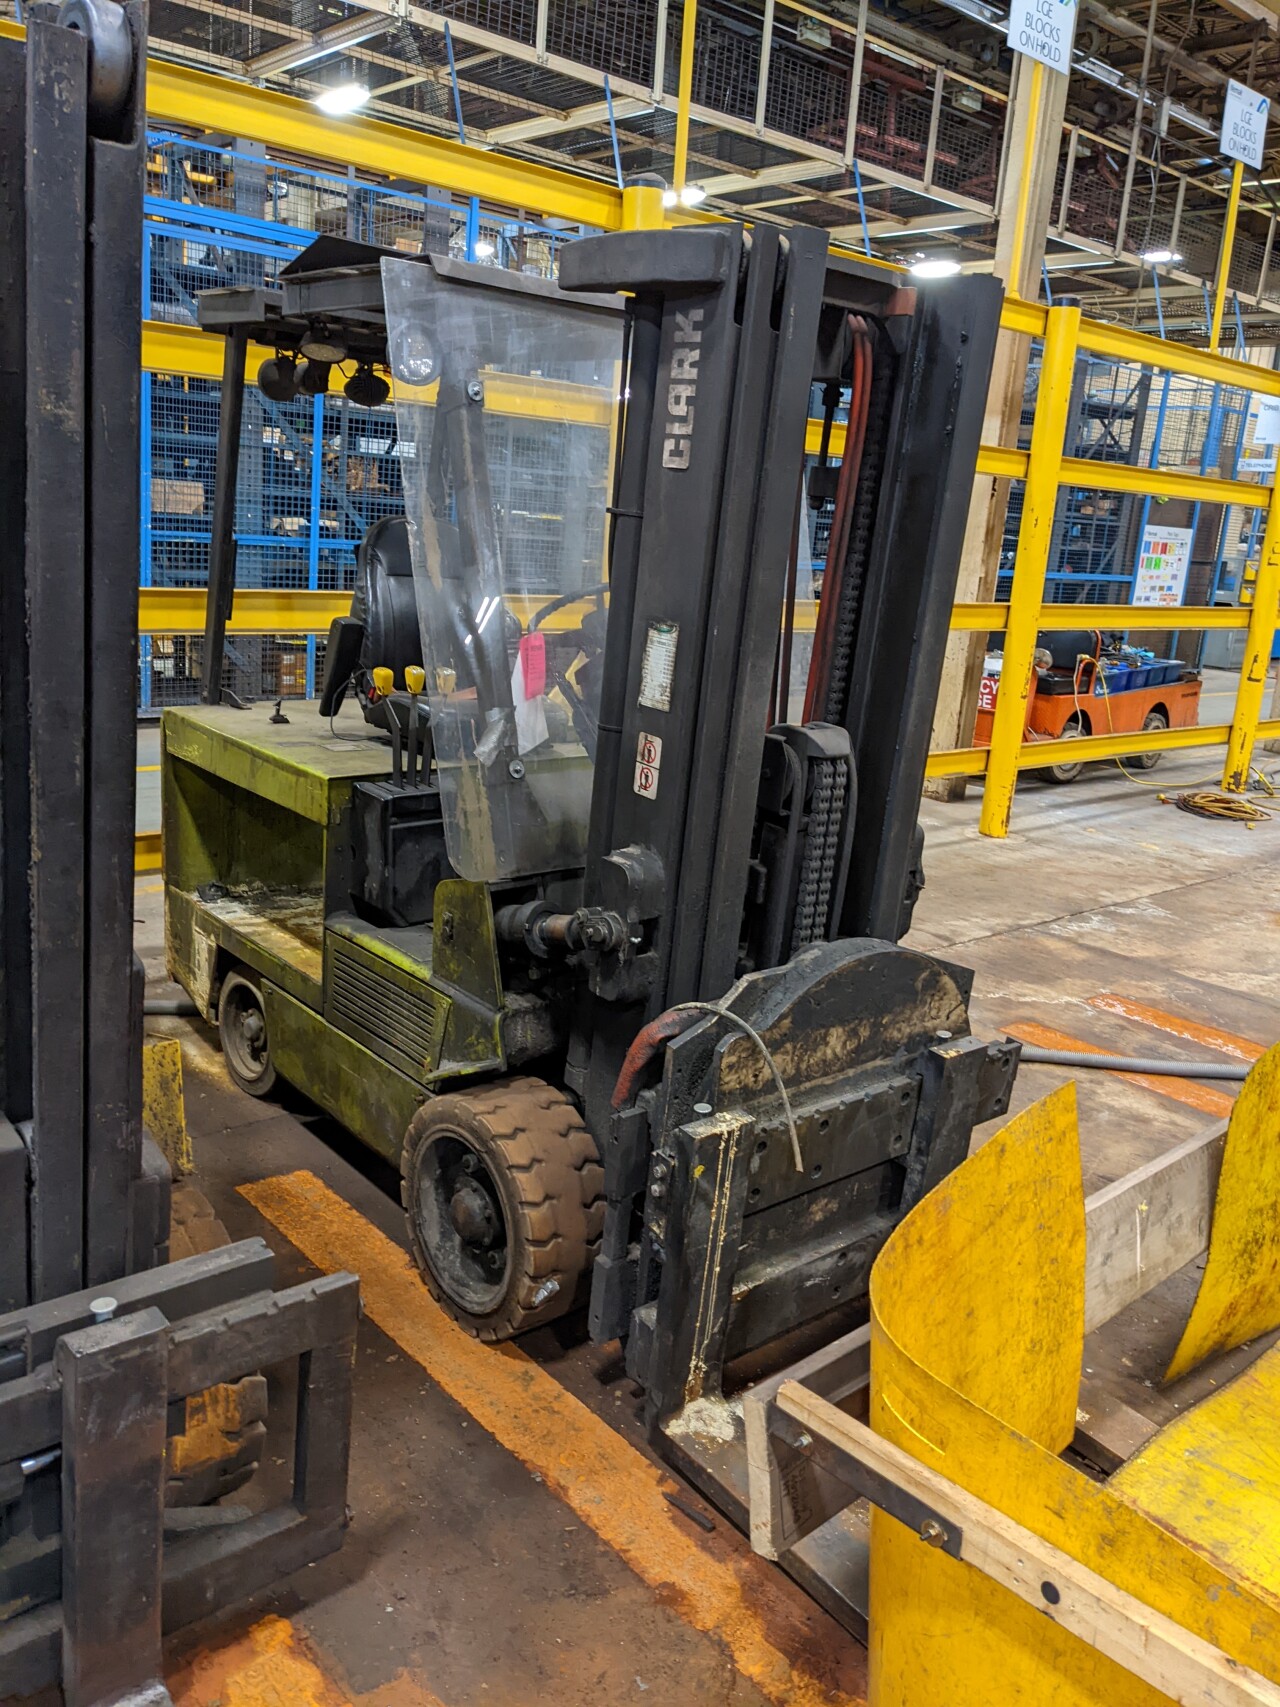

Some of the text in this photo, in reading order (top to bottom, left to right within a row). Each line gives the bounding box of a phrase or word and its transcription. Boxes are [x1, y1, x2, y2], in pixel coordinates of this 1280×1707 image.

[1024, 11, 1061, 44] BLOCKS
[1232, 121, 1257, 145] BLOCKS
[662, 308, 704, 470] CLARK
